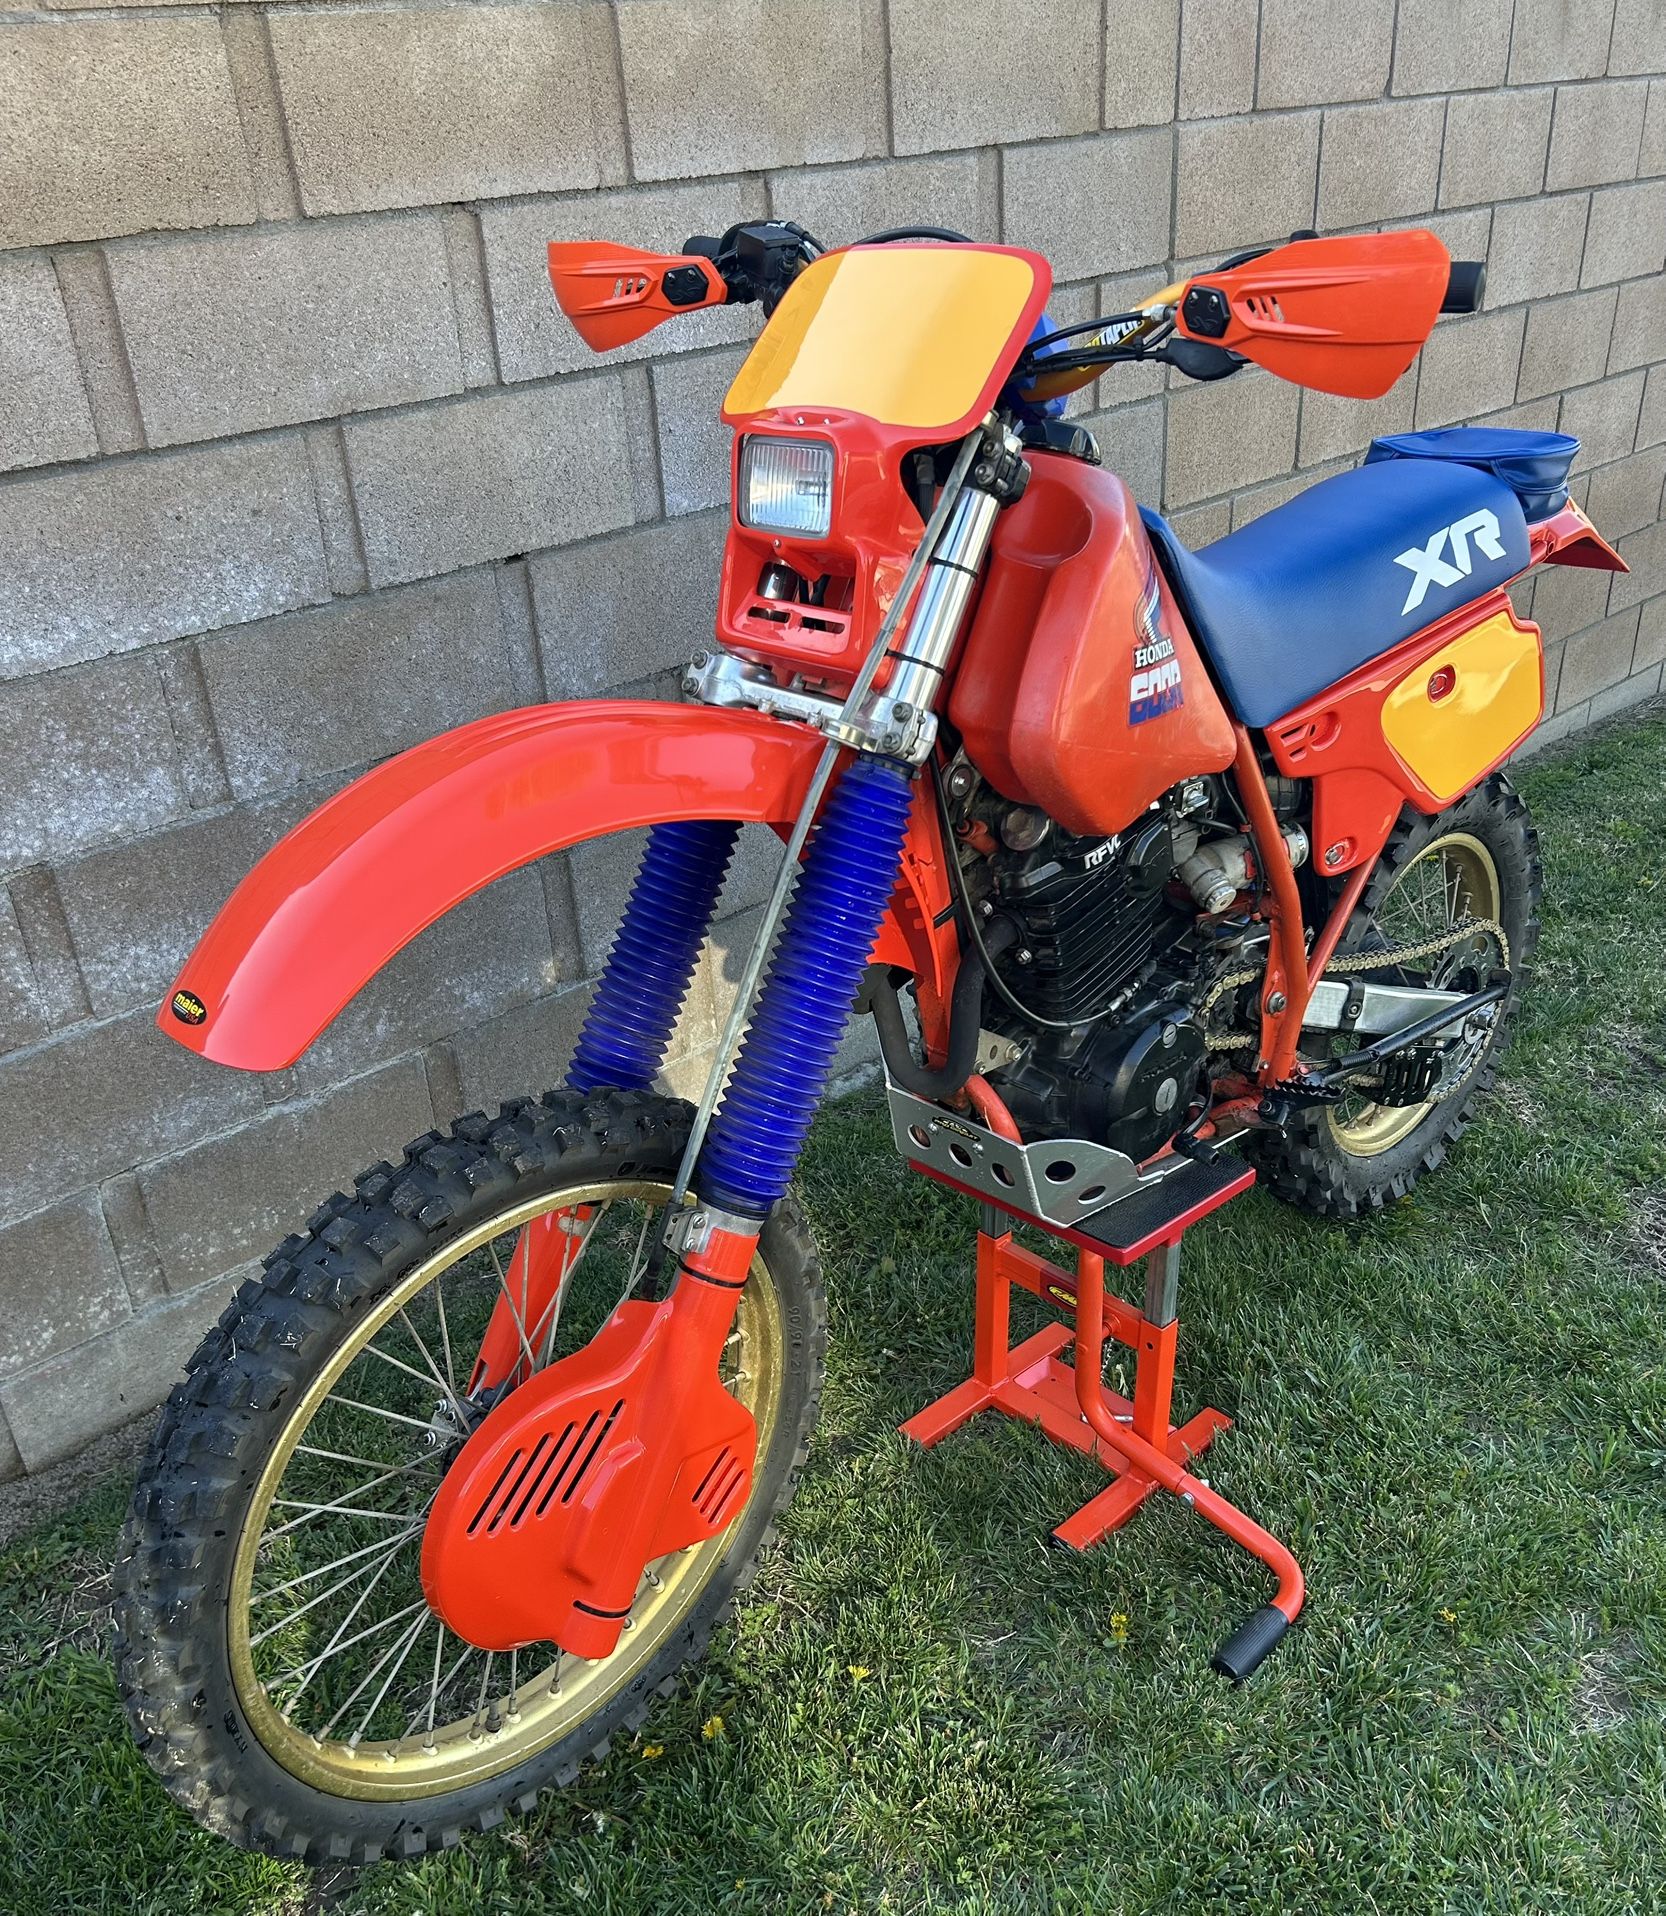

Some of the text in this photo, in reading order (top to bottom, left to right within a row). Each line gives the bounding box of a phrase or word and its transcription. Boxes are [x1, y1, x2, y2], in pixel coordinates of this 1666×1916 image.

[1392, 508, 1507, 616] XR
[1133, 638, 1175, 669] HONDA
[174, 992, 204, 1018] maier
